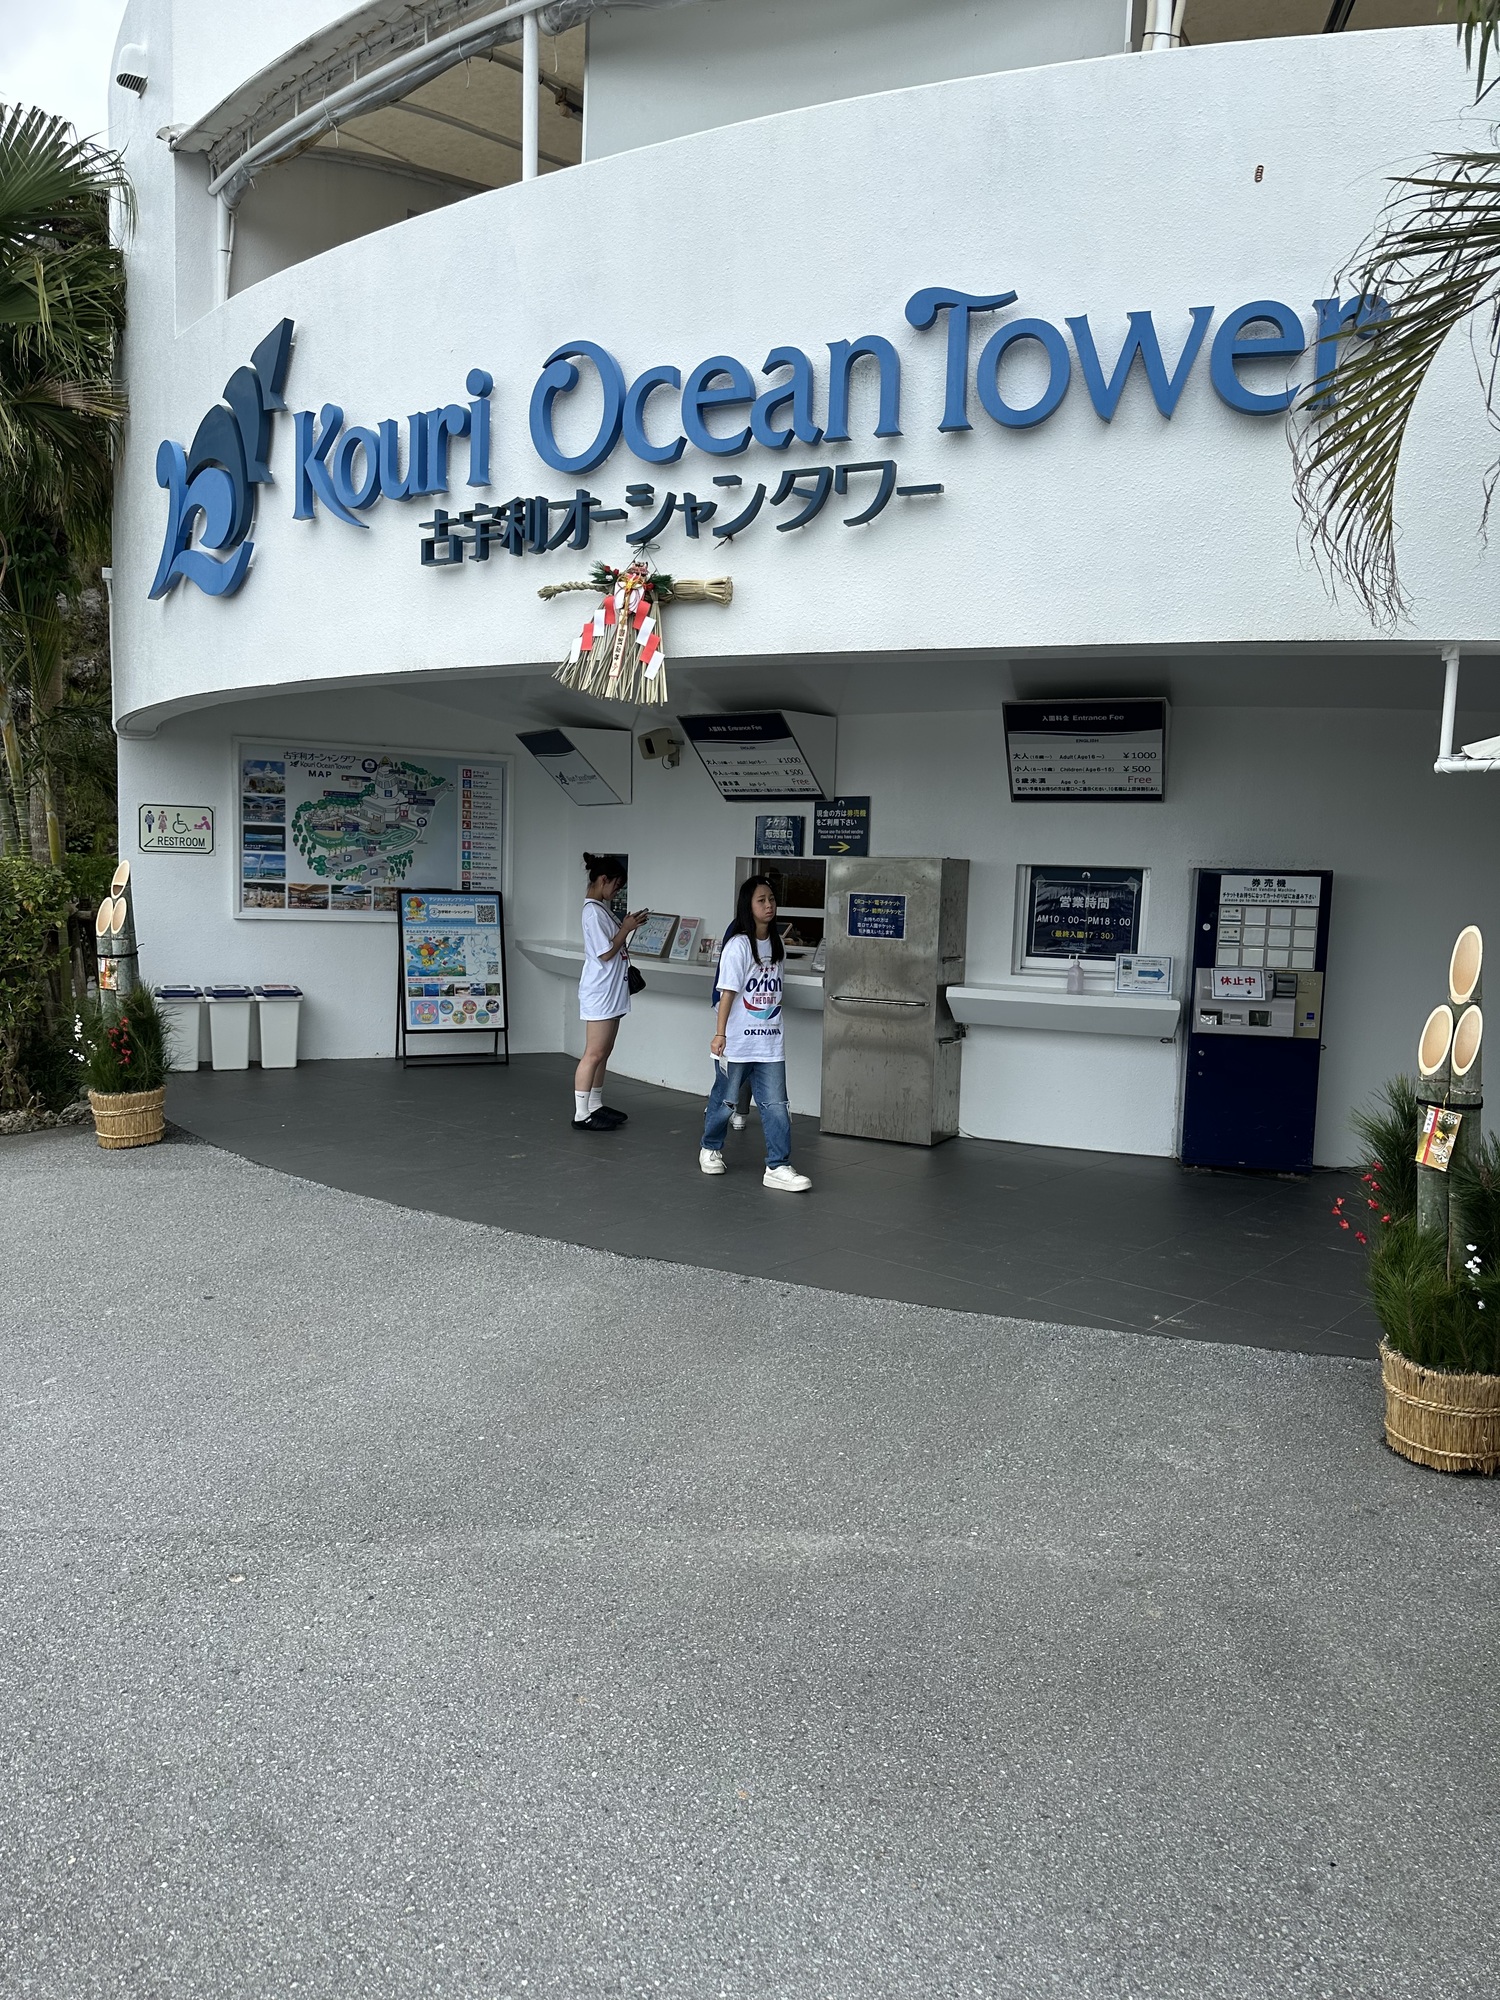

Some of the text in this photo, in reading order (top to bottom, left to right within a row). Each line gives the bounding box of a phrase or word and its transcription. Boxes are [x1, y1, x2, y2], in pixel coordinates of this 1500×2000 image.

[293, 286, 1391, 529] Kouri Ocean Tower
[418, 459, 945, 567] 古宇利オーシャンタワー
[283, 751, 361, 765] 古宇利オーシャンタワー
[316, 761, 335, 769] Ocean
[308, 770, 332, 778] MAP
[1127, 775, 1152, 783] Free
[816, 809, 867, 817] 現金の方は券売機
[766, 817, 793, 829] チケット
[816, 818, 857, 826] をご利用下さい
[157, 836, 206, 847] RESTROOM
[1252, 878, 1287, 888] 券売機
[1059, 895, 1110, 910] 営業時間
[1220, 976, 1256, 986] 休止中
[752, 996, 762, 1004] THE
[744, 1028, 781, 1036] OKINAWA
